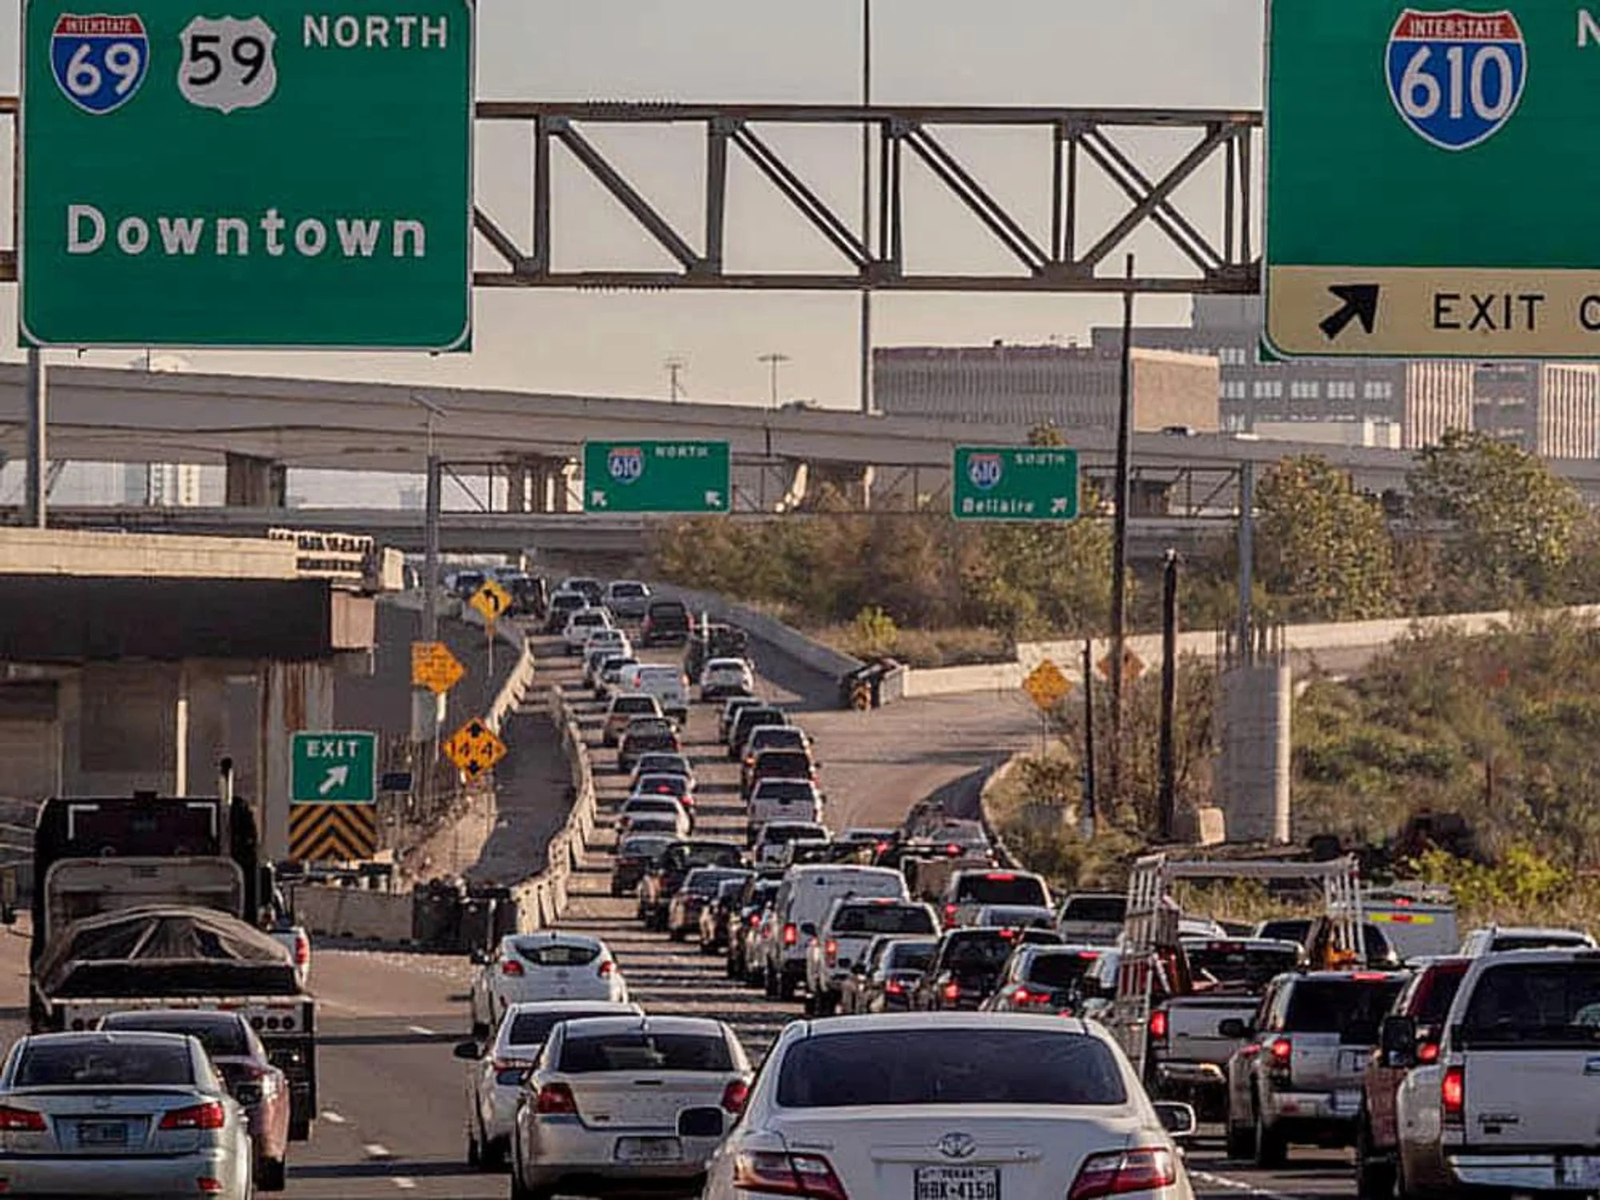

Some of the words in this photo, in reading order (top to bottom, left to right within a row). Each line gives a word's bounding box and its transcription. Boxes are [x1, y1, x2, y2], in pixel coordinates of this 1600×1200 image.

[65, 19, 133, 33] INTERSTATE
[303, 14, 448, 49] NORTH
[1409, 19, 1503, 38] INTERSTATE
[65, 43, 140, 96] 69
[187, 35, 267, 87] 59
[1400, 45, 1513, 121] 610
[67, 203, 426, 257] Downtown
[1433, 293, 1545, 331] EXIT
[655, 446, 709, 459] NORTH
[611, 456, 643, 478] 610
[970, 460, 1001, 481] 610
[962, 497, 1035, 514] Bellaire
[306, 740, 360, 758] EXIT
